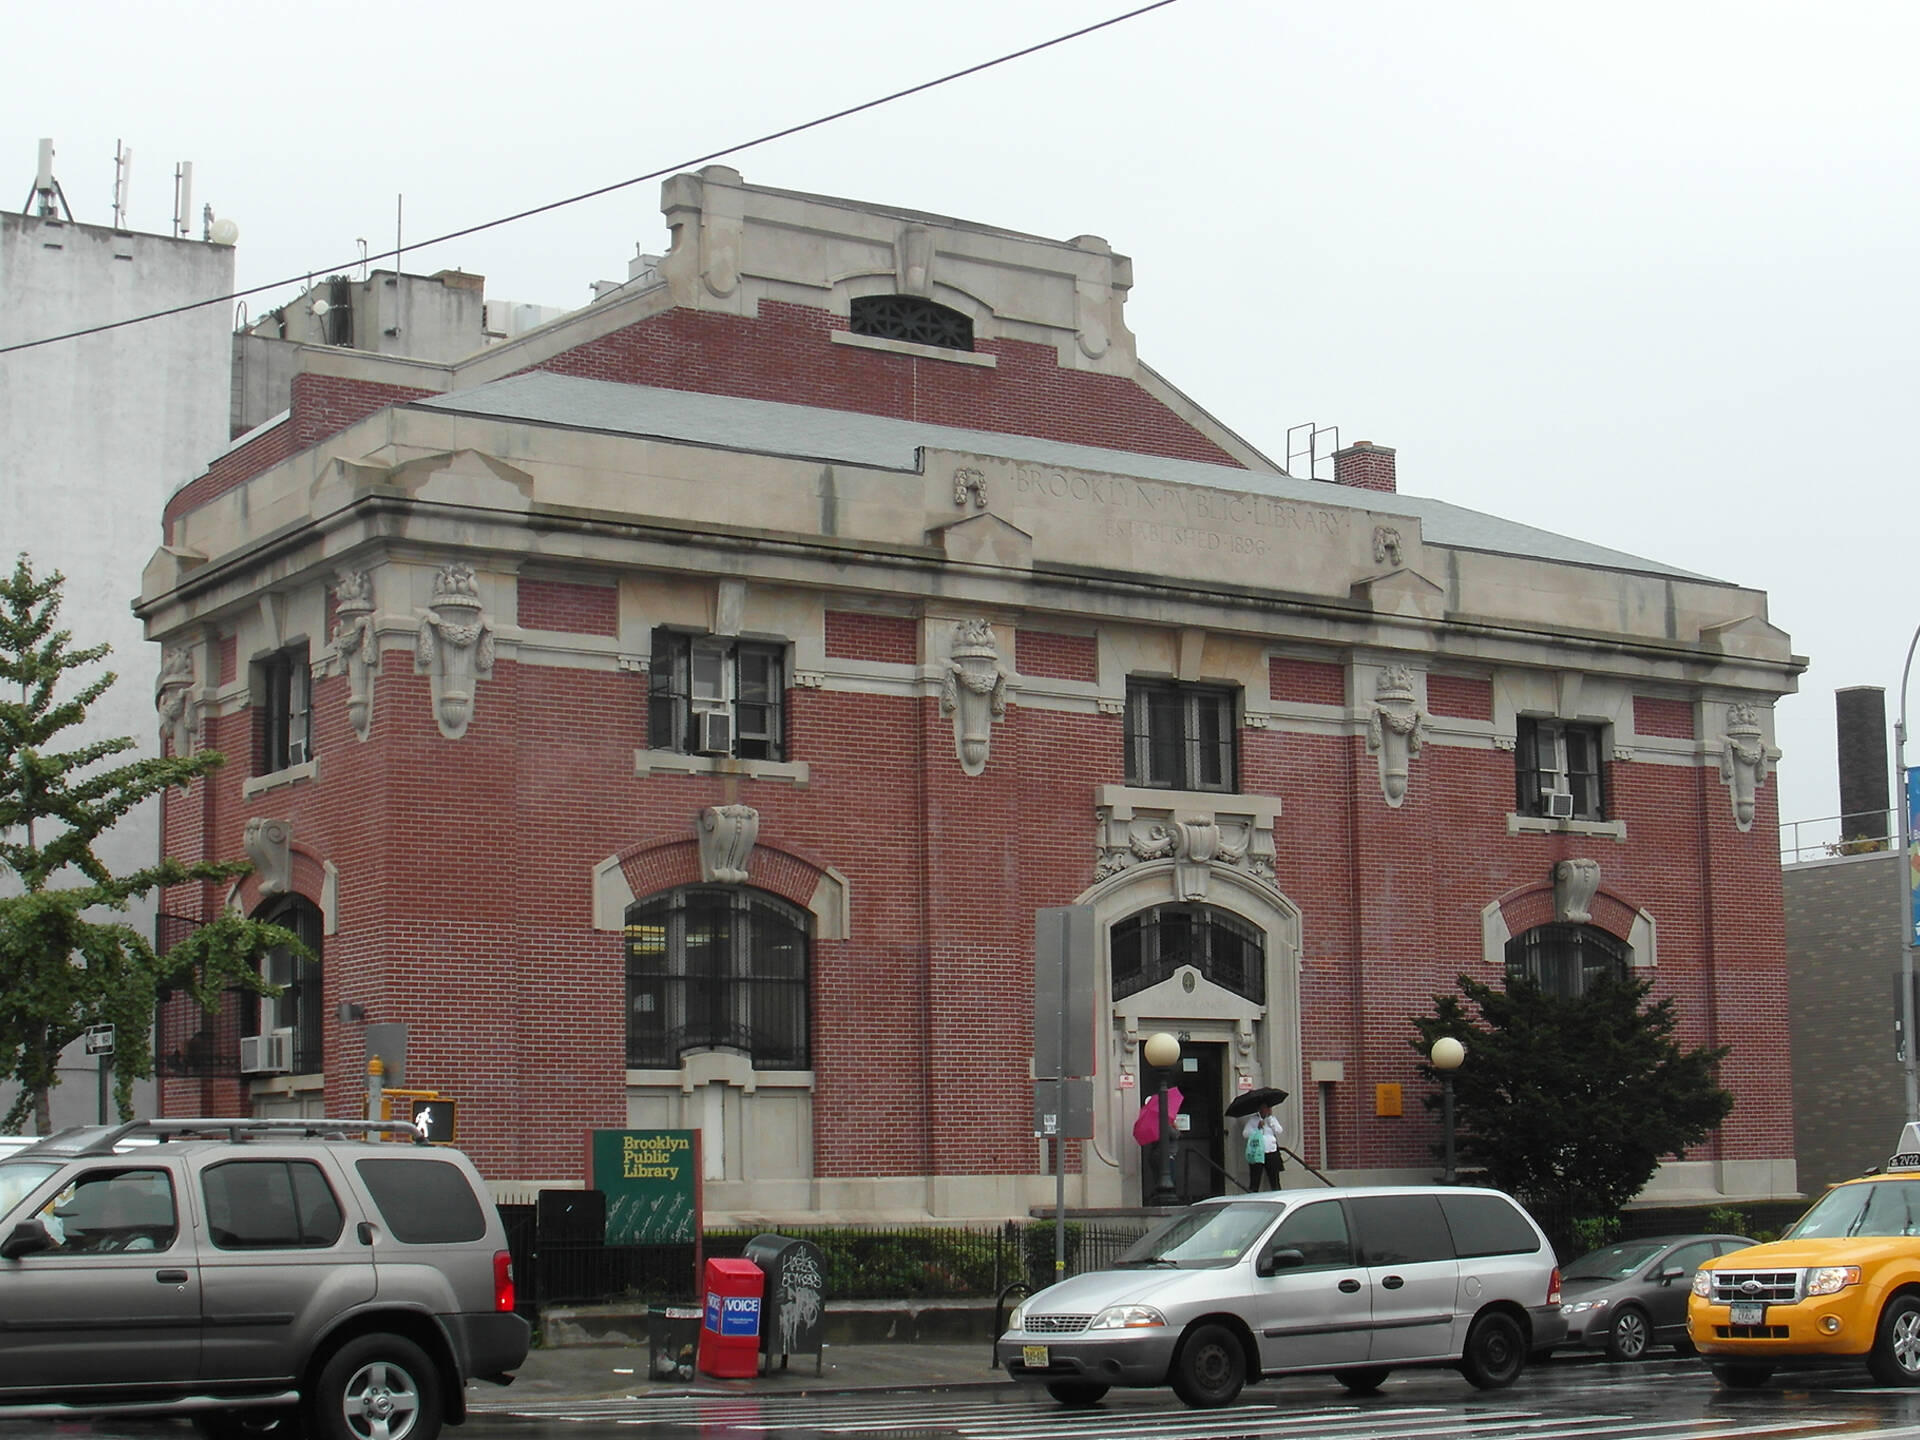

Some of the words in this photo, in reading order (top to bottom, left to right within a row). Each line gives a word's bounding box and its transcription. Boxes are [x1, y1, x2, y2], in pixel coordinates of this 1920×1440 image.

[1017, 467, 1155, 509] BROOKLYN
[1255, 501, 1344, 536] LIBRARY
[1105, 518, 1220, 550] ESTABLISHED
[1231, 535, 1265, 556] 1896
[624, 1135, 689, 1152] Brooklyn
[624, 1150, 670, 1164] Public
[624, 1164, 679, 1180] Library
[727, 1299, 758, 1312] VOICE
